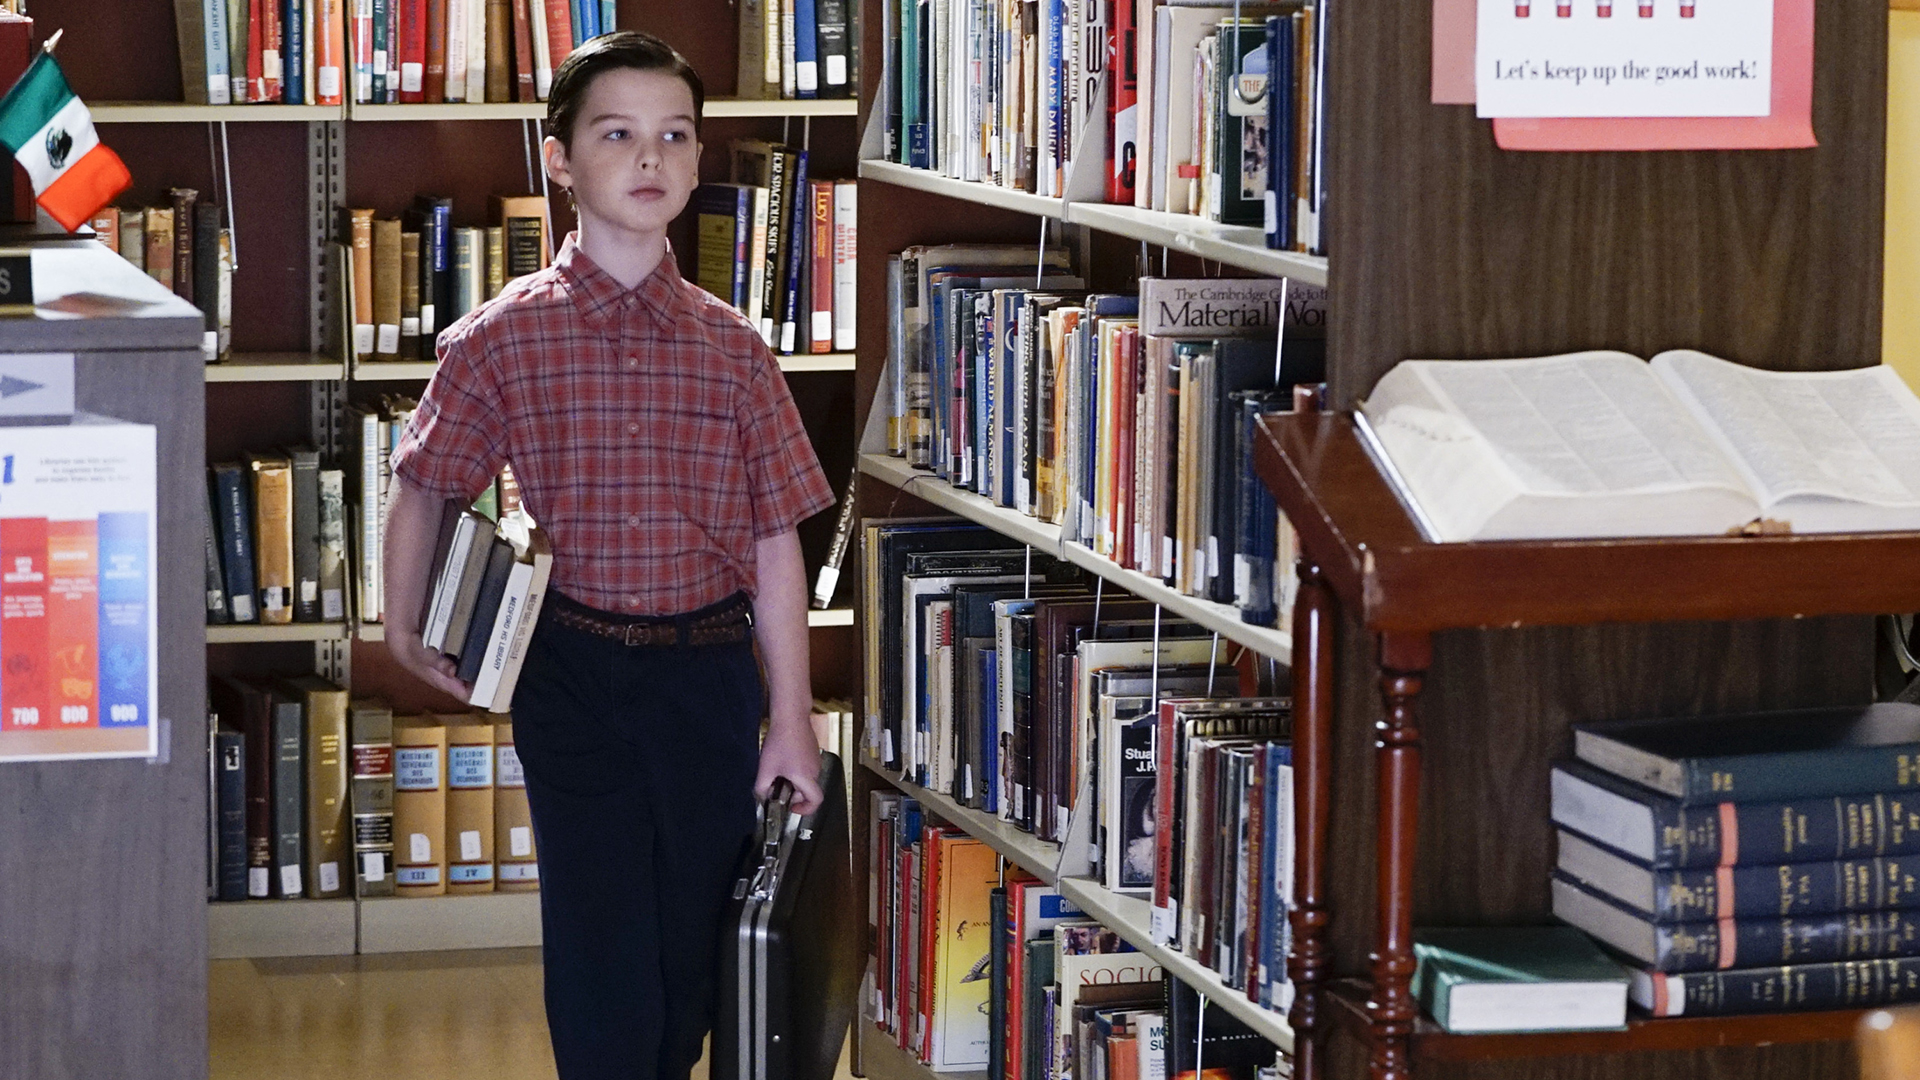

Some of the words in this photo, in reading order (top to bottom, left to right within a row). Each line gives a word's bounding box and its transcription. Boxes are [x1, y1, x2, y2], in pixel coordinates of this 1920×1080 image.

[1048, 66, 1057, 105] MARY
[1243, 80, 1261, 93] THE
[1495, 60, 1539, 80] Let's
[1545, 60, 1587, 86] keep
[1593, 65, 1612, 86] up
[1622, 60, 1650, 80] the
[1655, 60, 1698, 83] good
[1704, 60, 1757, 80] work!
[772, 152, 784, 173] FOR
[768, 174, 782, 225] SPACIOUS
[815, 191, 831, 222] Lucy
[767, 226, 779, 254] SKIES
[1175, 288, 1197, 300] The
[1200, 287, 1266, 302] Cambridge
[1159, 301, 1269, 327] Material
[987, 351, 996, 402] WORLD
[1022, 371, 1030, 409] WITH
[1145, 357, 1155, 445] MODERN
[1021, 412, 1029, 473] JAPAN
[504, 596, 518, 629] MEDFORD
[501, 631, 509, 641] HS
[493, 641, 507, 670] LIBRARY
[12, 707, 39, 725] 700
[1156, 871, 1166, 907] RANDAL
